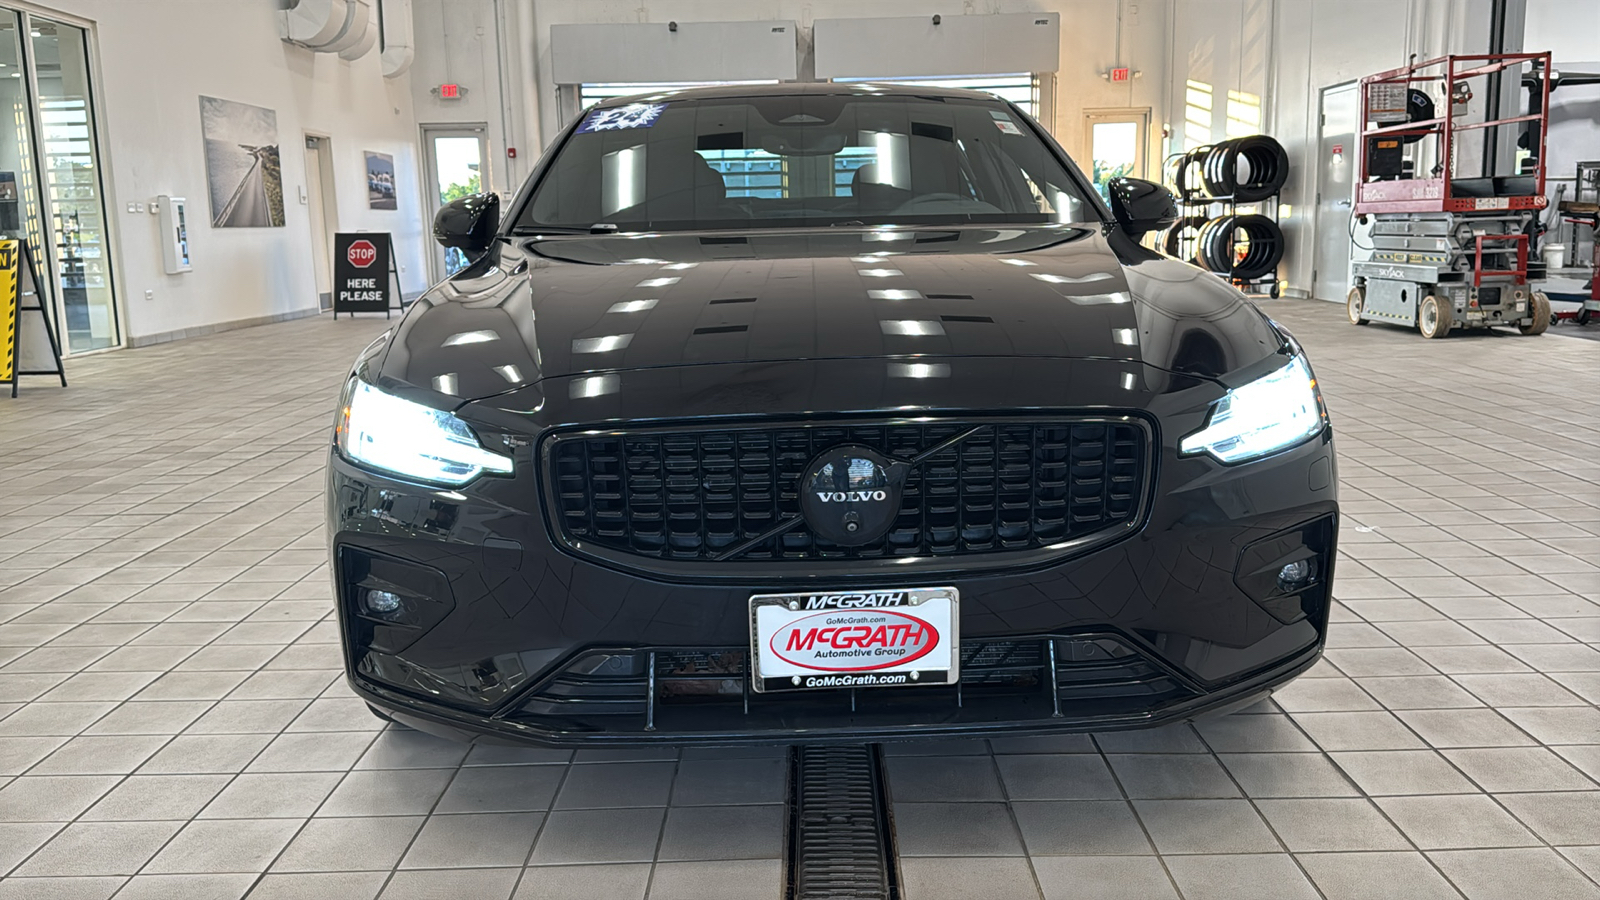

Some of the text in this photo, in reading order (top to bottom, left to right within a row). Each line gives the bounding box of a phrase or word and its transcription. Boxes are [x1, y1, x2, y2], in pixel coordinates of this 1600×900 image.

[1112, 68, 1128, 81] EXIT
[442, 84, 457, 97] EXIT
[349, 248, 375, 260] STOP
[1378, 266, 1405, 279] SKYJACK
[347, 278, 376, 289] HERE
[340, 291, 383, 301] PLEASE
[816, 490, 887, 503] VOLVO
[826, 616, 887, 626] GoMcGrath.com
[814, 647, 906, 659] Automotive Group
[806, 674, 907, 688] GoMcGrath.com
